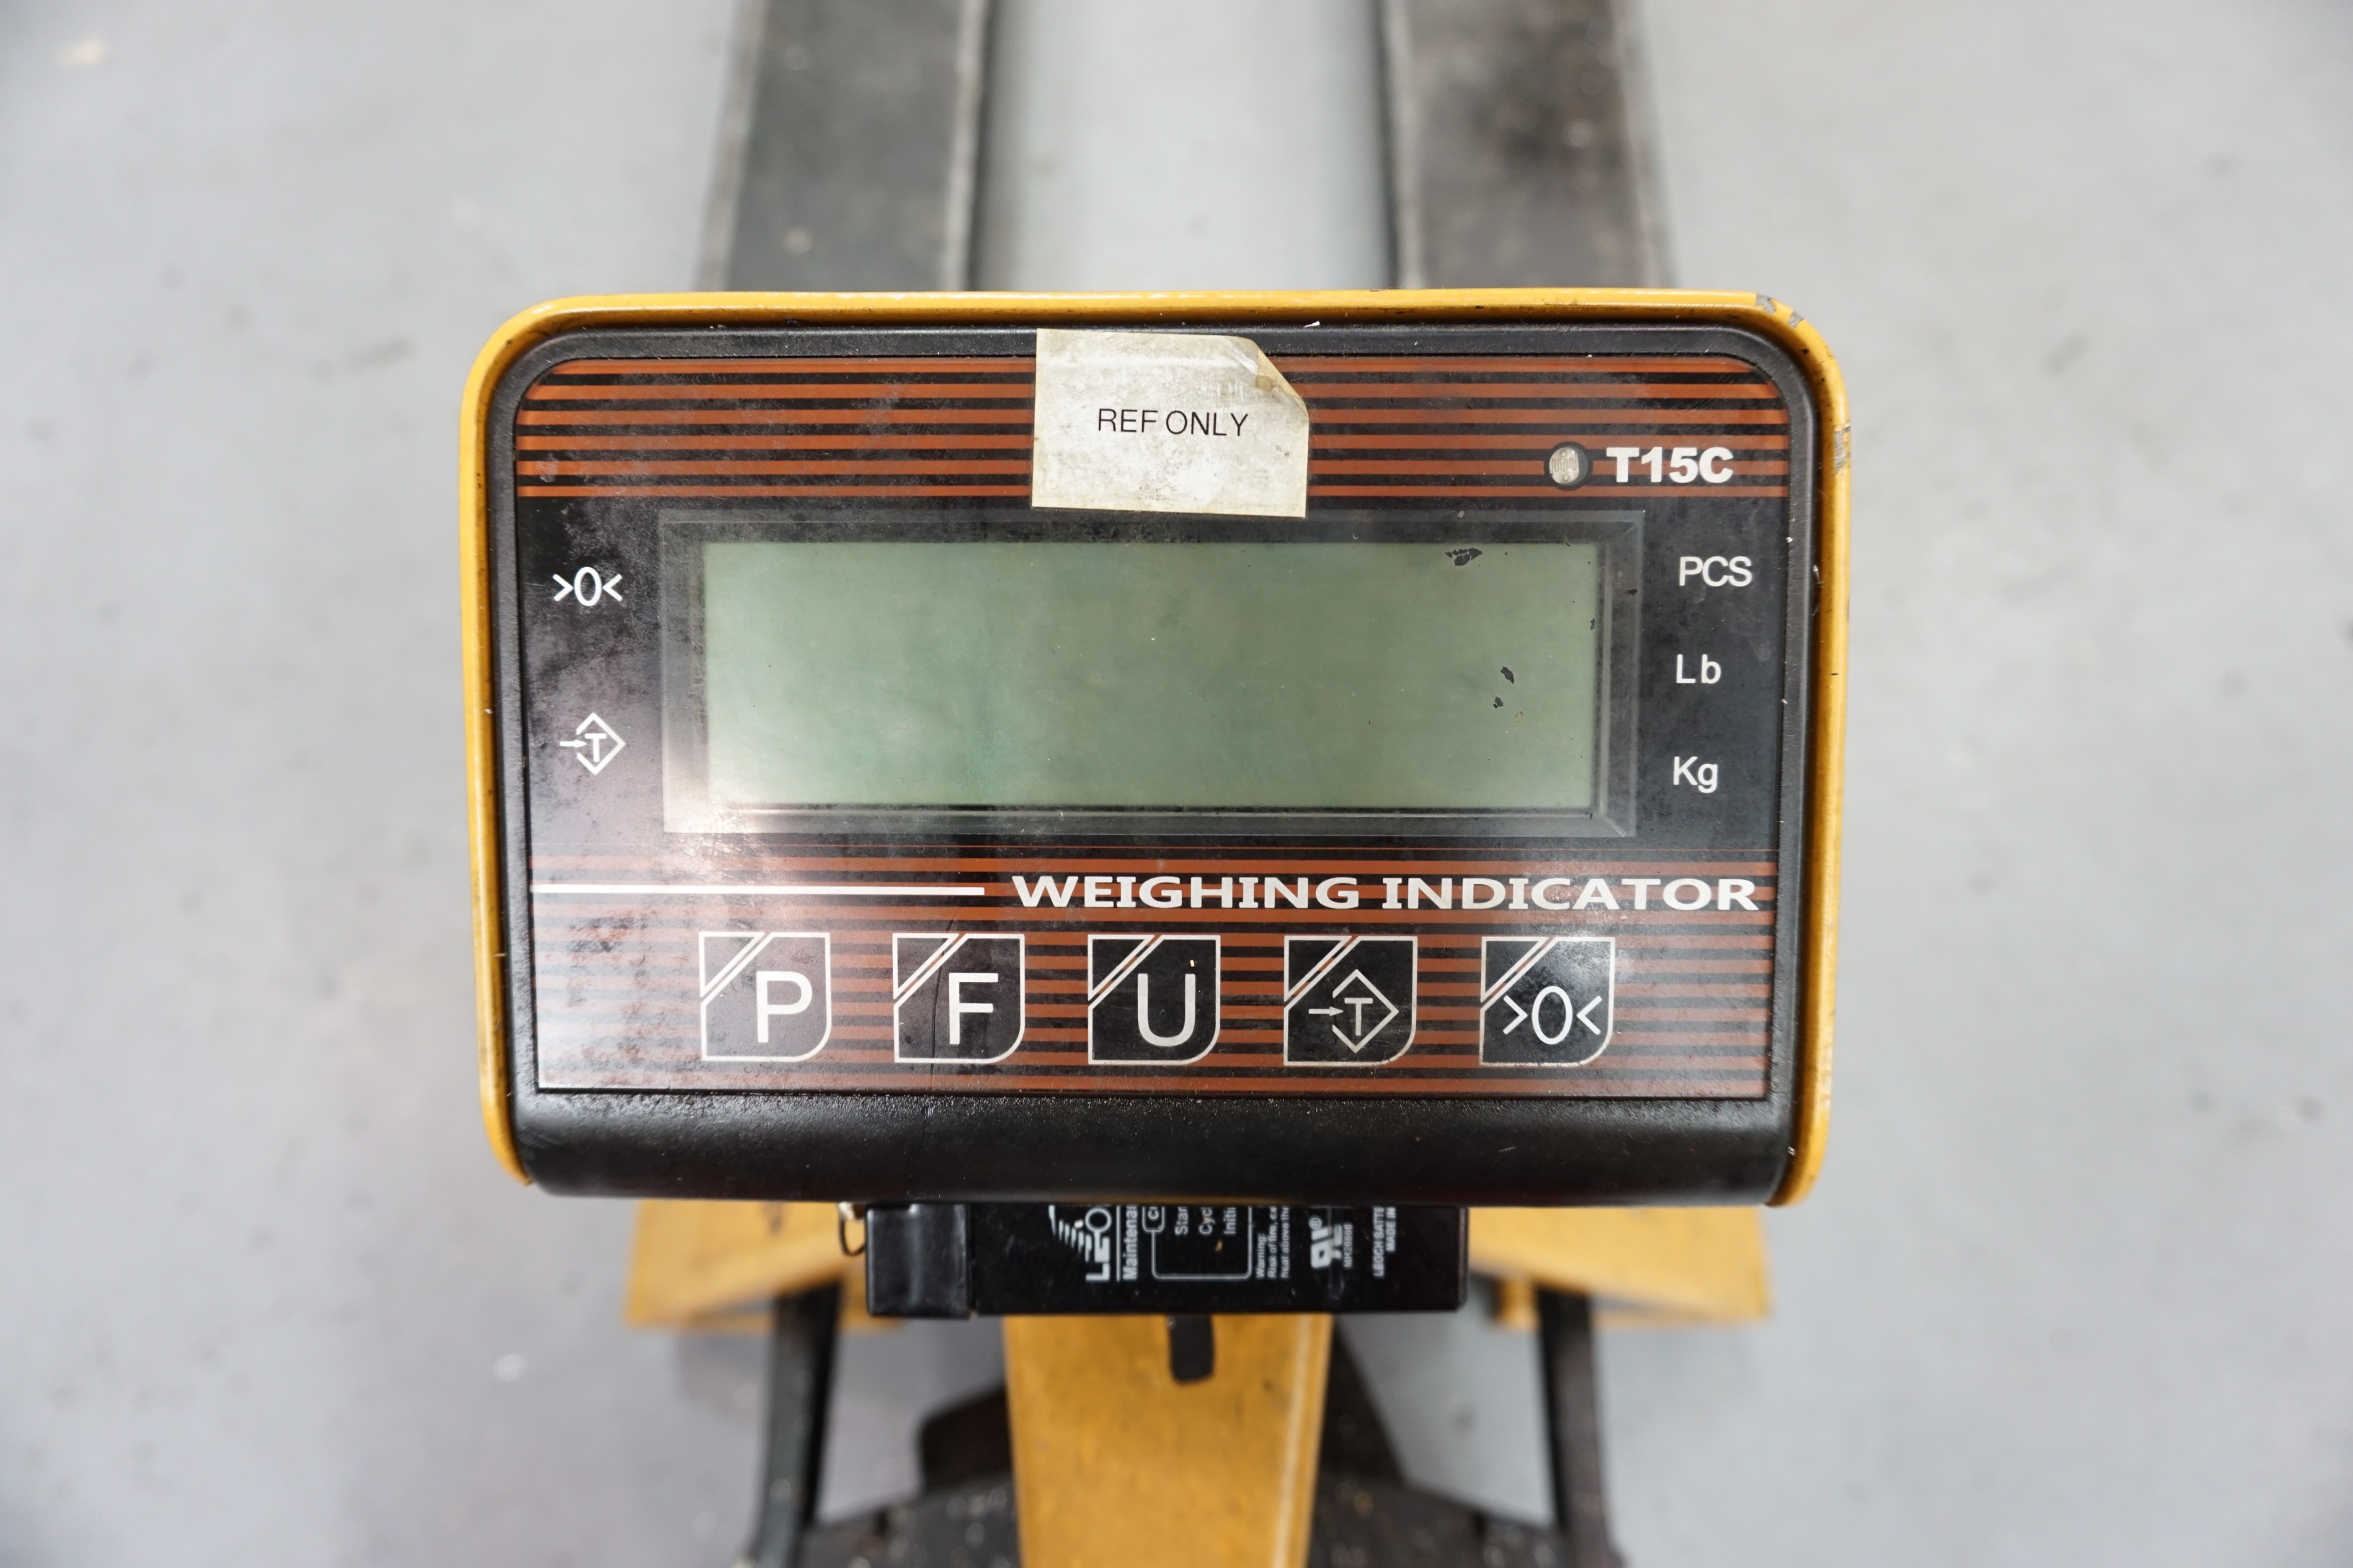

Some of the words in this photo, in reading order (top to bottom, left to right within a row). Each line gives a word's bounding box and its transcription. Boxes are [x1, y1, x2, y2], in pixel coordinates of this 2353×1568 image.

[1098, 408, 1158, 433] REF
[1166, 410, 1249, 437] ONLY
[1606, 446, 1733, 484] T15C
[1678, 556, 1753, 587] PCS
[1675, 654, 1722, 685] Lb
[1672, 756, 1719, 793] Kg
[1011, 875, 1360, 910] WEIGHING
[1382, 876, 1759, 911] INDICATOR
[757, 970, 813, 1043] P
[948, 972, 999, 1046] F
[1137, 973, 1196, 1047] U
[1085, 1206, 1111, 1281] LEO
[1268, 1241, 1277, 1253] of
[1280, 1222, 1289, 1253] above
[1386, 1221, 1396, 1252] MADE
[1255, 1233, 1267, 1278] Warning:
[1267, 1256, 1277, 1278] Risk
[1372, 1240, 1384, 1277] LEOCH
